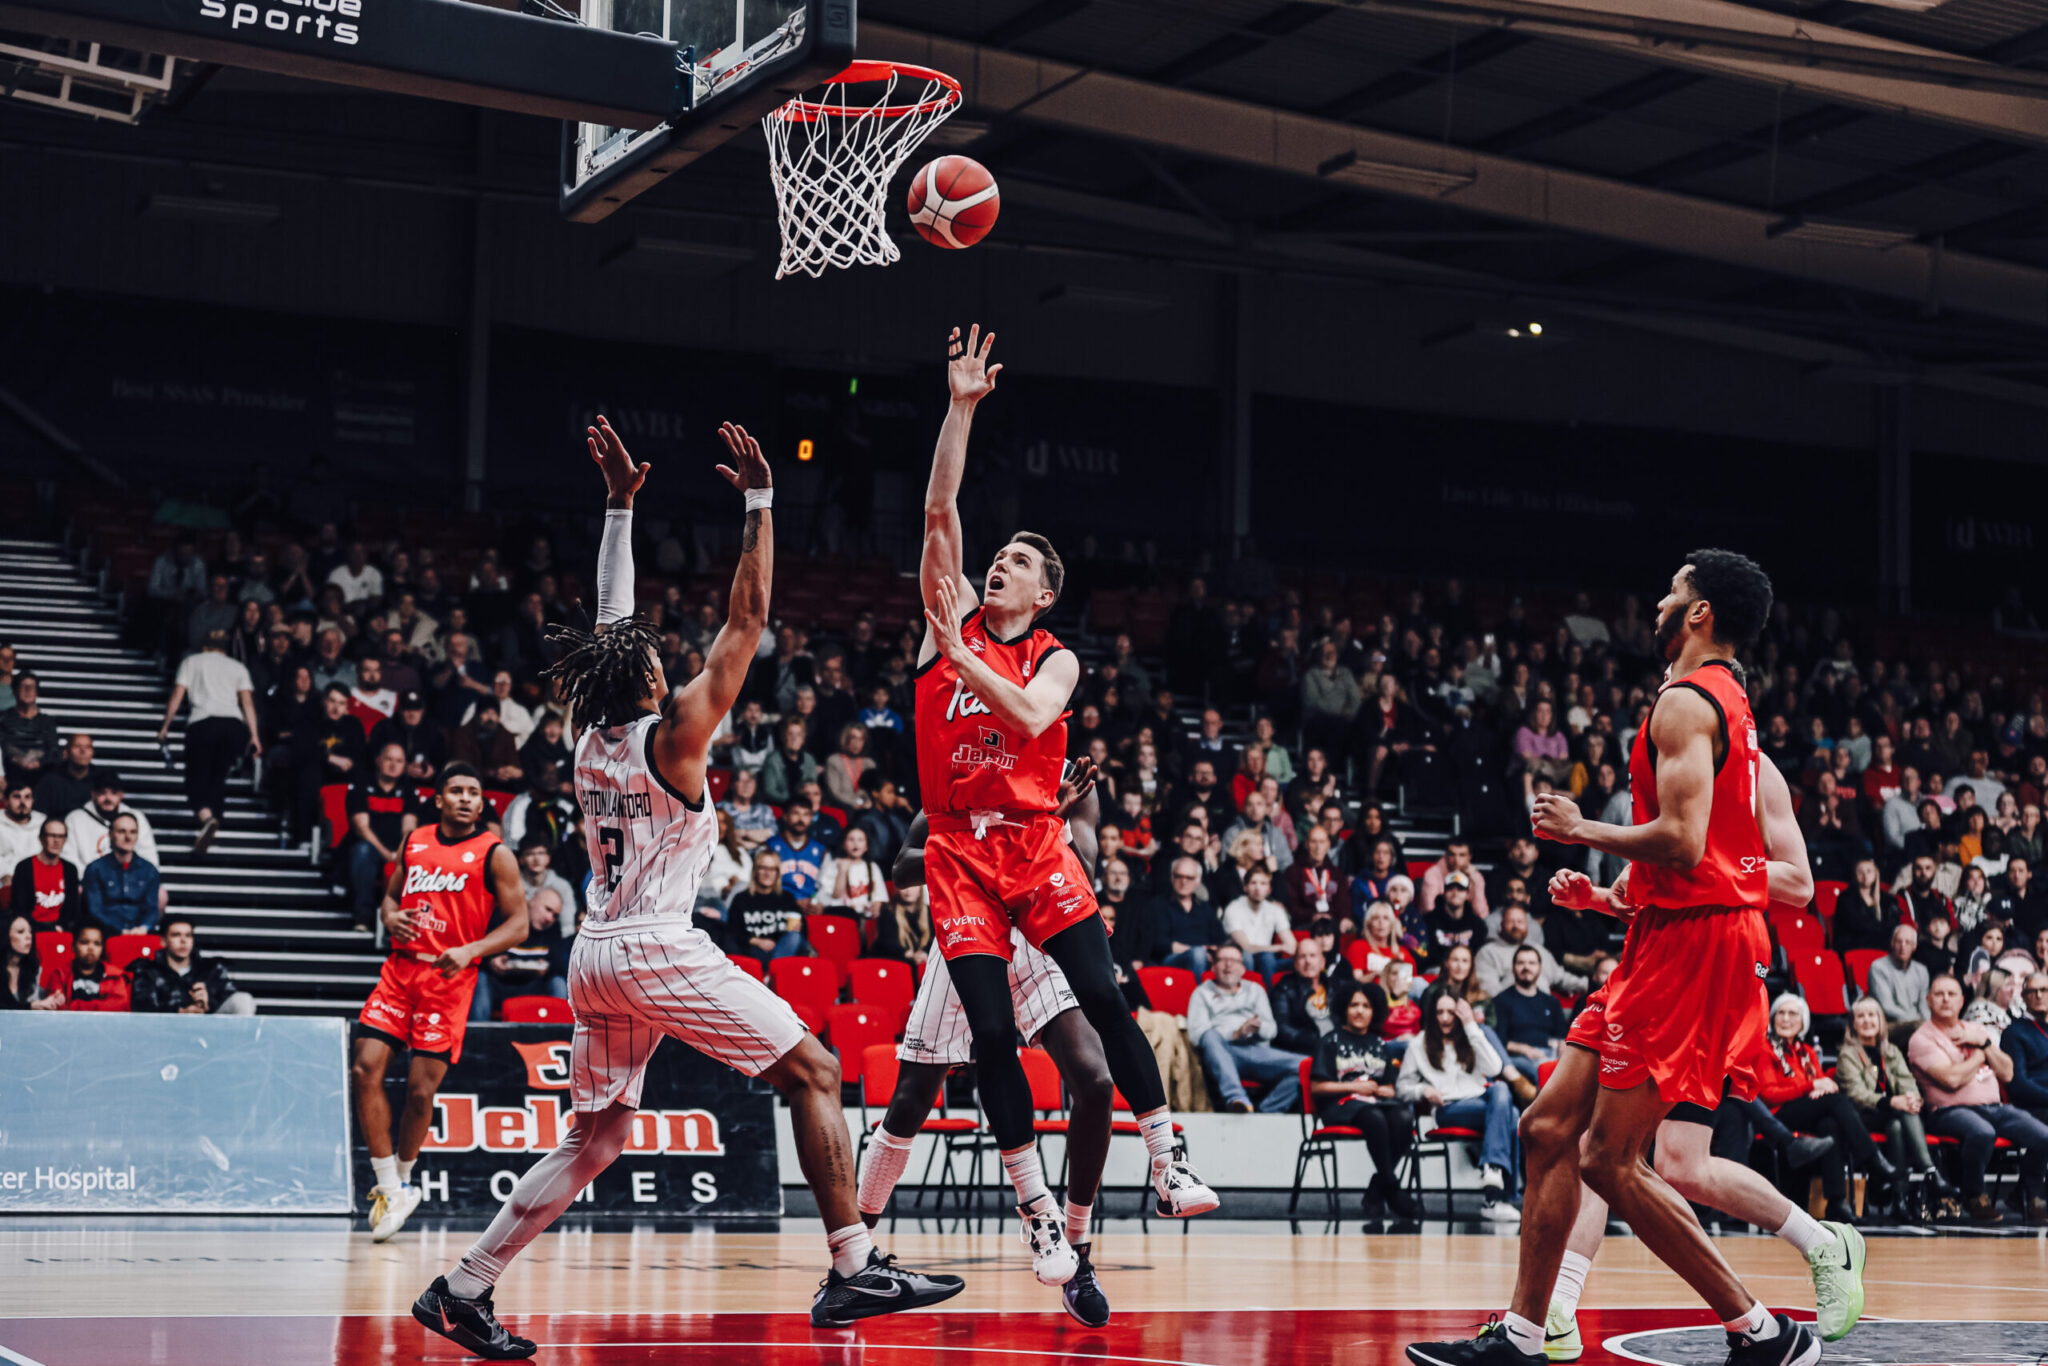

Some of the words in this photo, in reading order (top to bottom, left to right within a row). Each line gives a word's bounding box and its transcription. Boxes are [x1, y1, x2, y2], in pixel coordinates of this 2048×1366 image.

[200, 0, 360, 45] sports
[797, 438, 815, 461] 0
[600, 827, 624, 893] 2
[402, 865, 468, 897] Riders
[0, 1171, 28, 1189] er
[35, 1165, 136, 1197] Hospital
